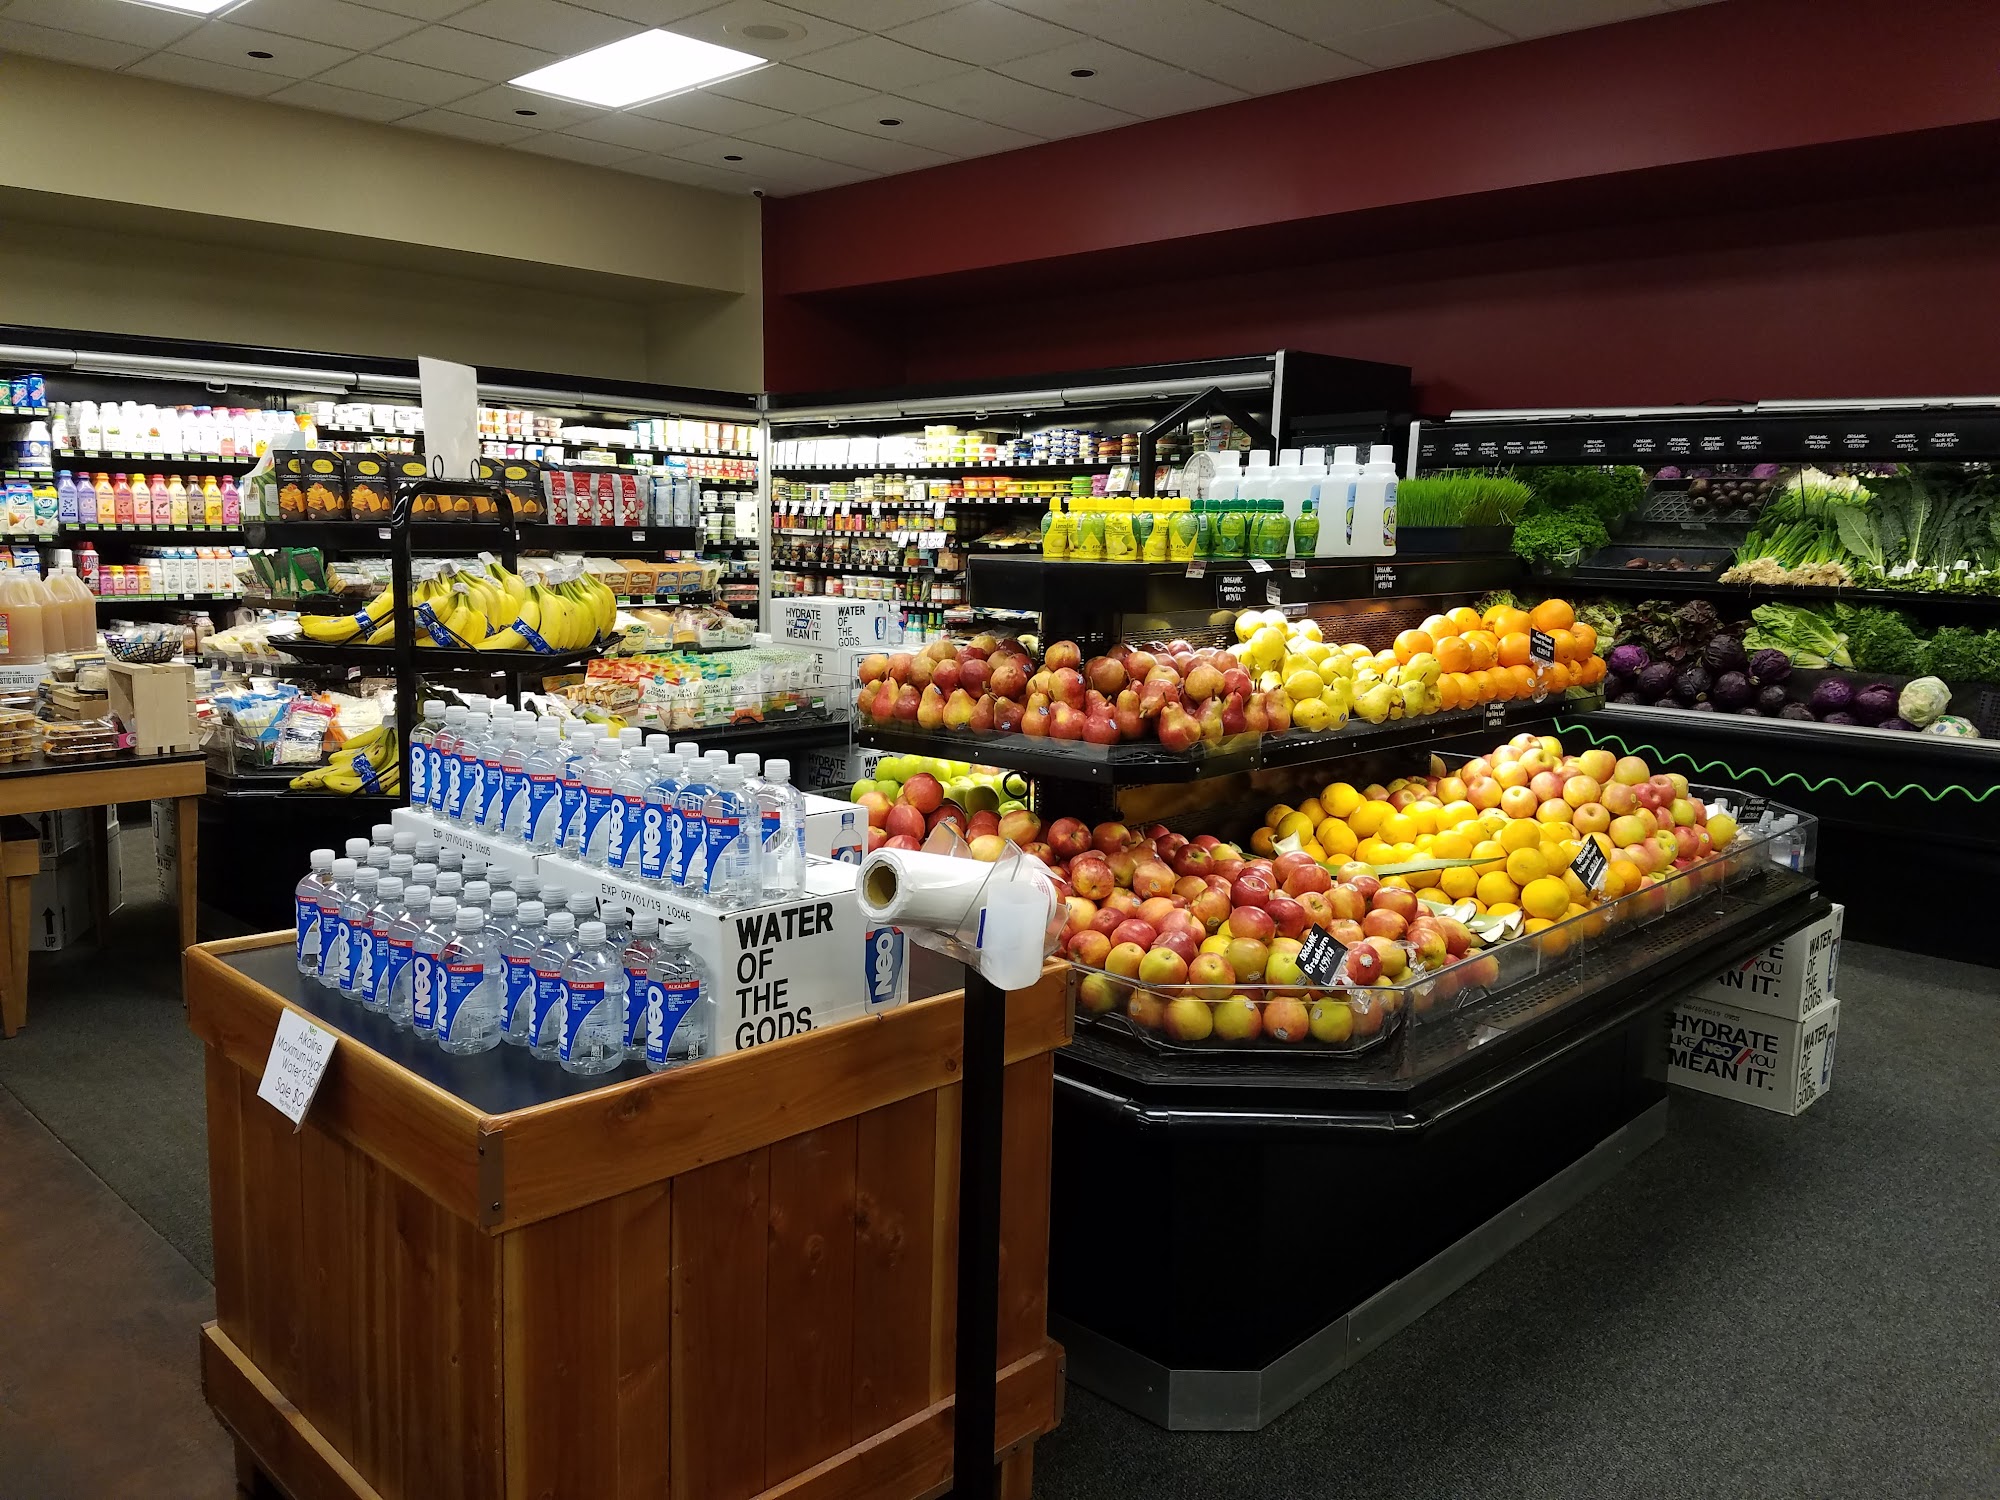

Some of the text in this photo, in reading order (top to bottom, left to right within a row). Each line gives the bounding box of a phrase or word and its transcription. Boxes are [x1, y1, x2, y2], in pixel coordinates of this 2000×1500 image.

[1220, 585, 1246, 593] Lemons
[786, 607, 821, 620] HYDRATE
[838, 606, 865, 616] WATER
[838, 617, 848, 626] OF
[787, 628, 809, 639] MEAN
[838, 627, 852, 636] THE
[865, 769, 876, 778] OF
[42, 842, 51, 853] UP
[433, 828, 443, 839] EXP
[445, 832, 472, 851] 07/01/19
[601, 883, 691, 922] EXP 07/01/19 10:46
[736, 902, 833, 950] WATER
[45, 936, 56, 947] UP
[1299, 932, 1319, 961] ORGANIC
[1809, 929, 1832, 956] WATER
[737, 948, 773, 984] OF
[1304, 937, 1329, 974] Braeburn
[1807, 956, 1816, 976] OF
[1755, 961, 1781, 975] YOU
[736, 978, 788, 1018] THE
[298, 1031, 322, 1054] Alkaline
[1673, 1013, 1778, 1054] HYDRATE
[1803, 1023, 1828, 1052] WATER
[276, 1035, 305, 1064] Maximum
[282, 1055, 302, 1078] Water
[1670, 1049, 1739, 1081] MEAN
[1749, 1054, 1775, 1069] YOU
[275, 1077, 291, 1098] Sale
